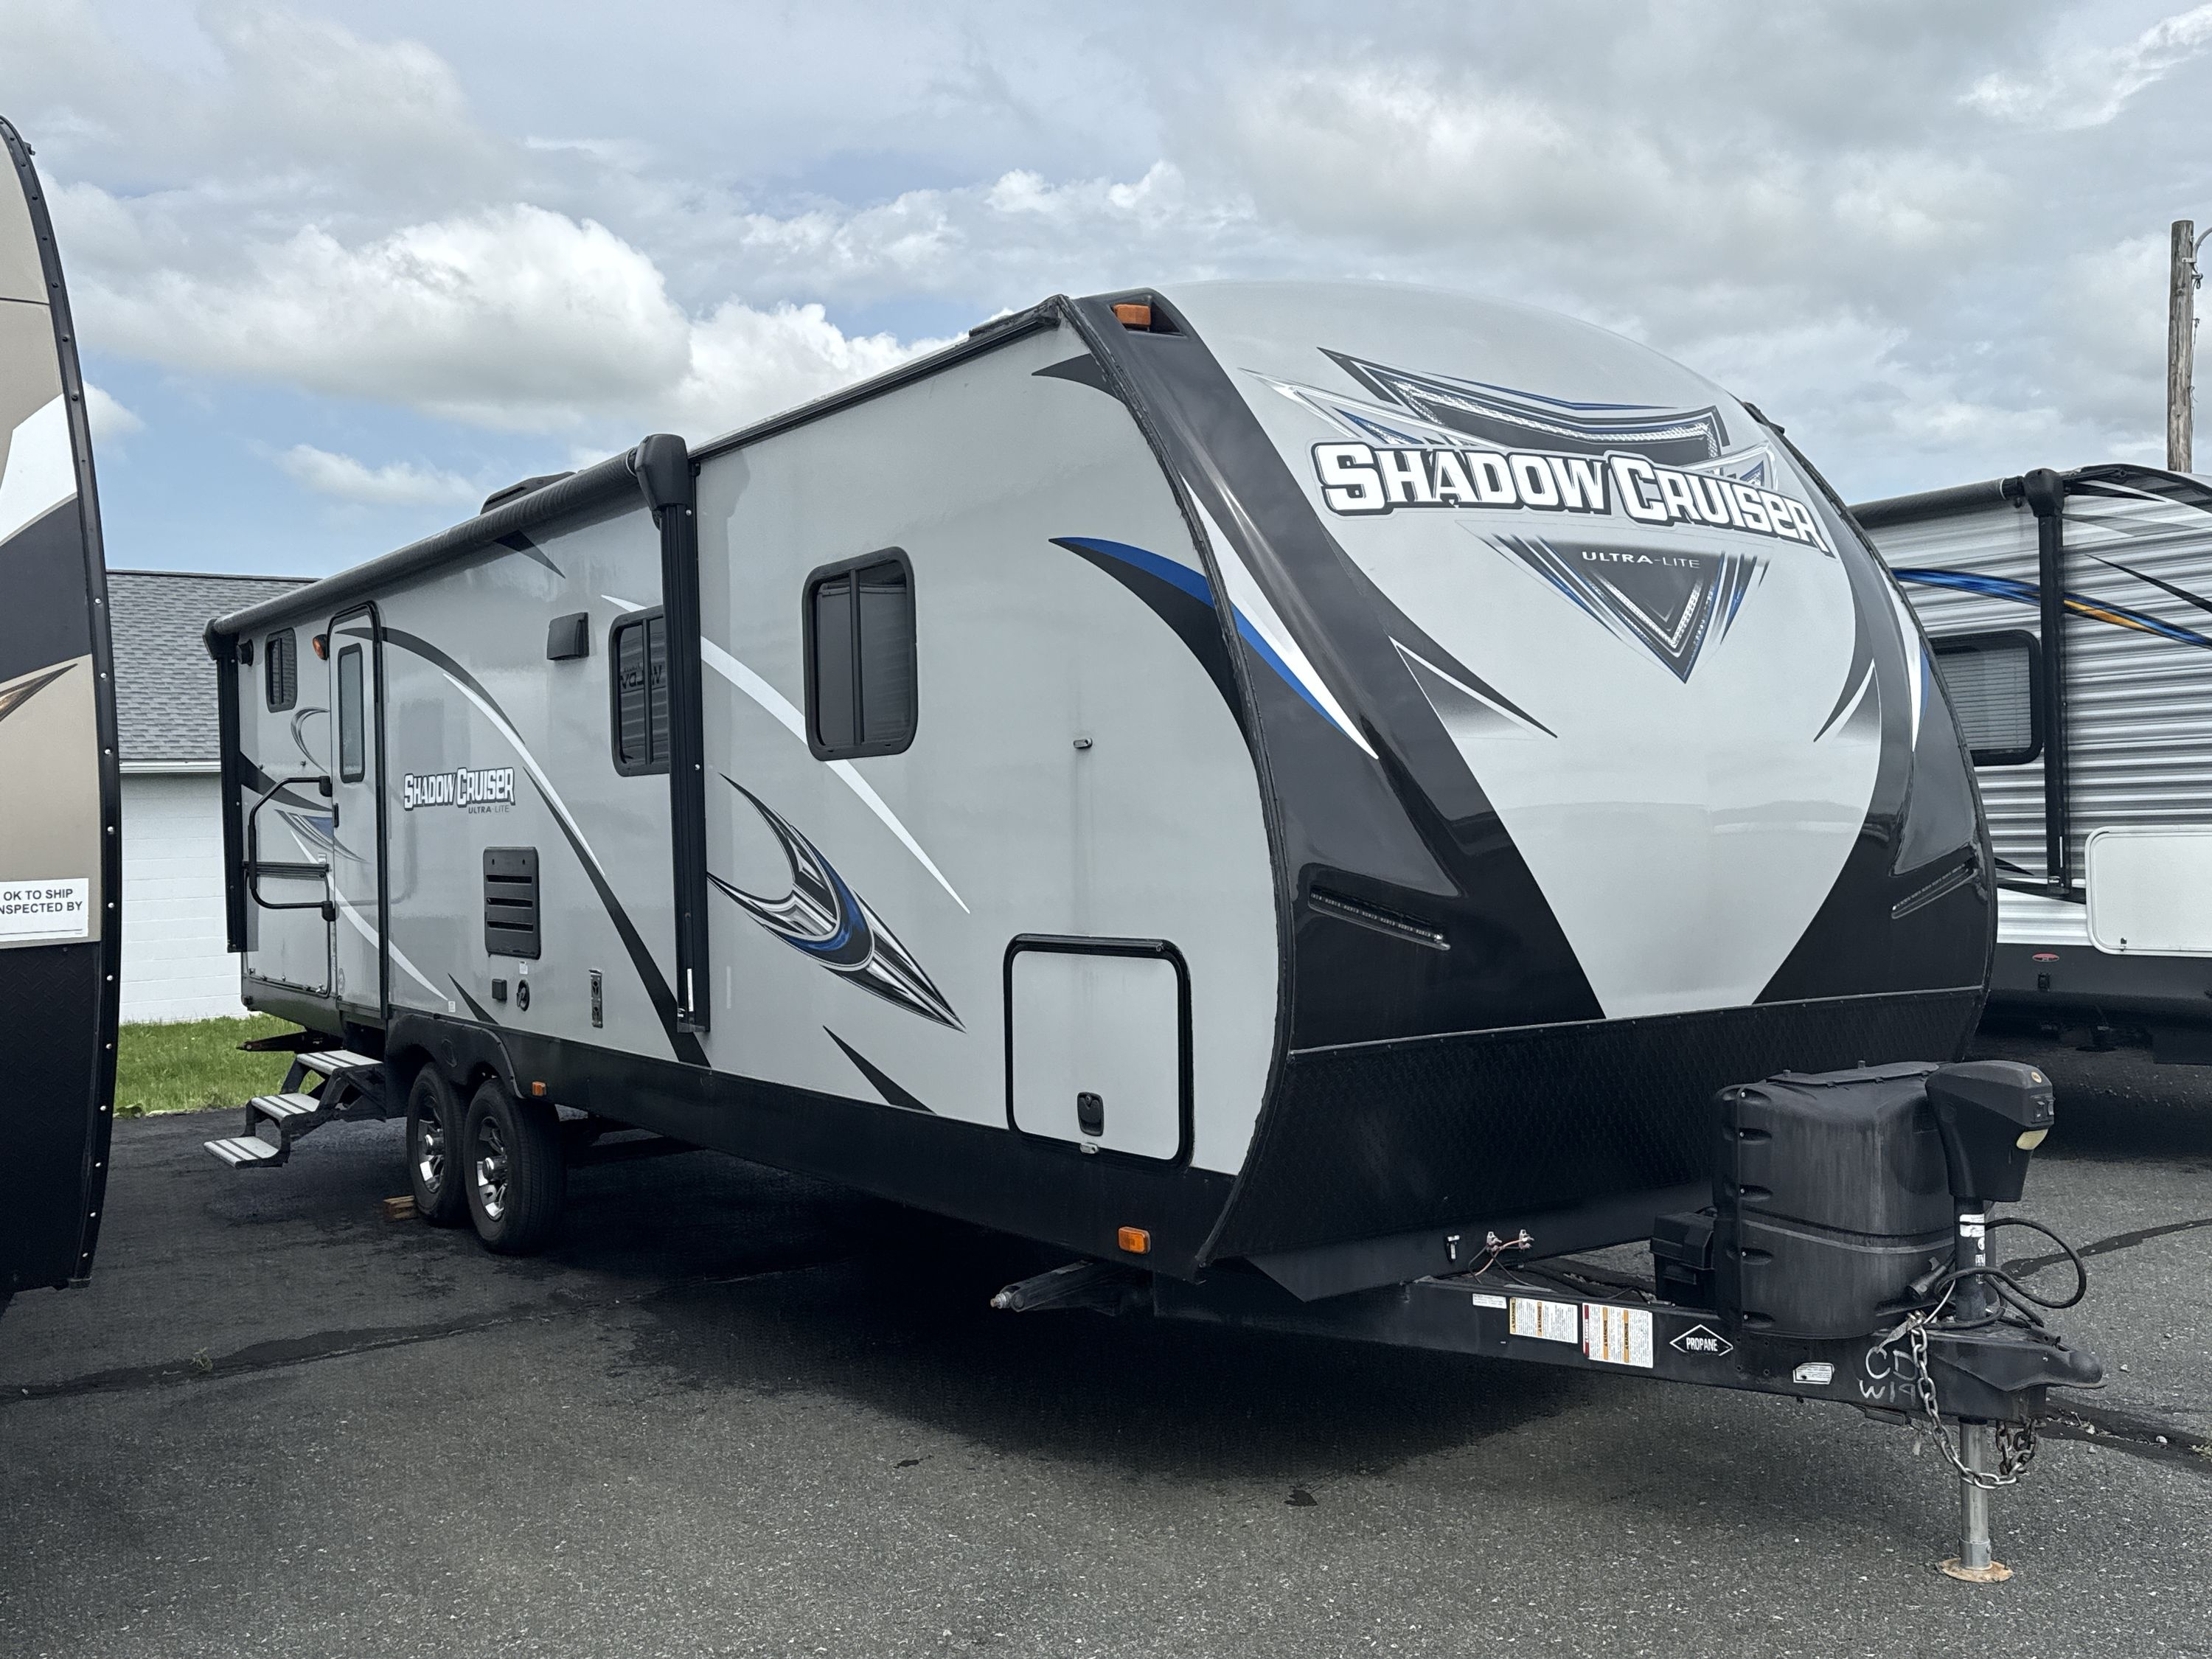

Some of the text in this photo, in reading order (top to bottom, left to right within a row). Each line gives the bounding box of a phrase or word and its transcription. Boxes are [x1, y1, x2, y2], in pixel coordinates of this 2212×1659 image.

[1312, 442, 1837, 560] SHADOW CRUISER
[1582, 552, 1701, 568] ULTRA-LITE
[404, 767, 515, 810] SHADOW CRUISER
[3, 888, 73, 901] OK TO SHIP
[66, 901, 83, 911] BY
[1686, 1337, 1718, 1352] PROPANE
[1865, 1346, 1918, 1381] CD
